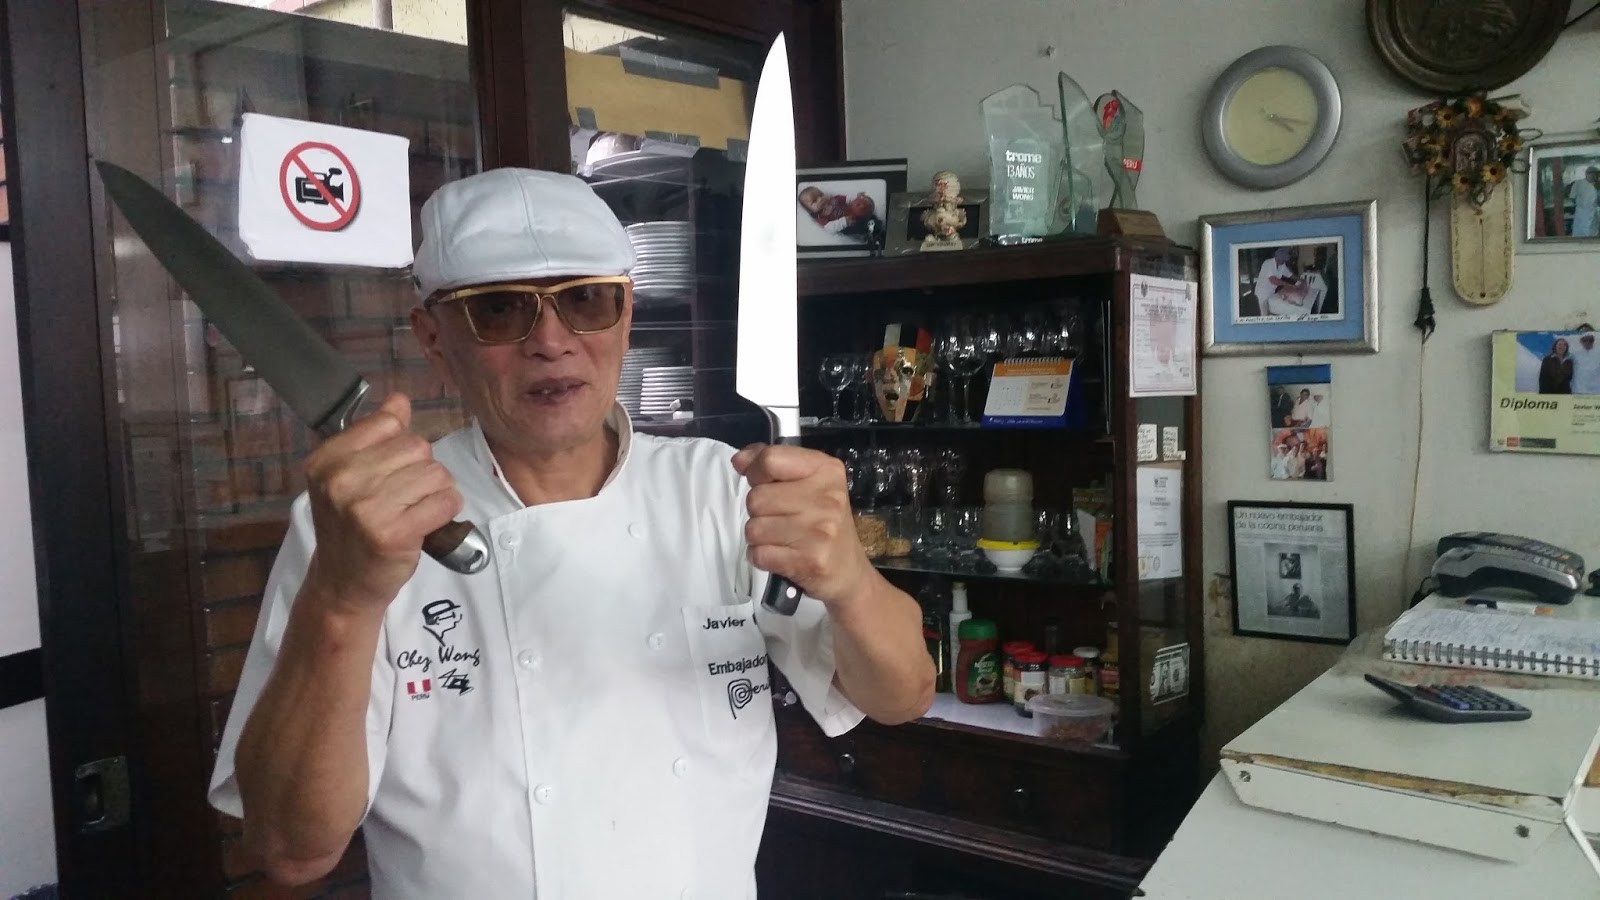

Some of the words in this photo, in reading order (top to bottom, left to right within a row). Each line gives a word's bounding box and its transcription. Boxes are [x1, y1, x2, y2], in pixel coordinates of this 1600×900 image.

[1005, 150, 1042, 163] trome
[1007, 164, 1015, 177] 13
[1015, 162, 1035, 179] AÑOS
[1500, 398, 1558, 411] Diploma
[703, 616, 746, 630] Javier
[397, 650, 431, 673] Chez
[438, 645, 480, 668] Wong
